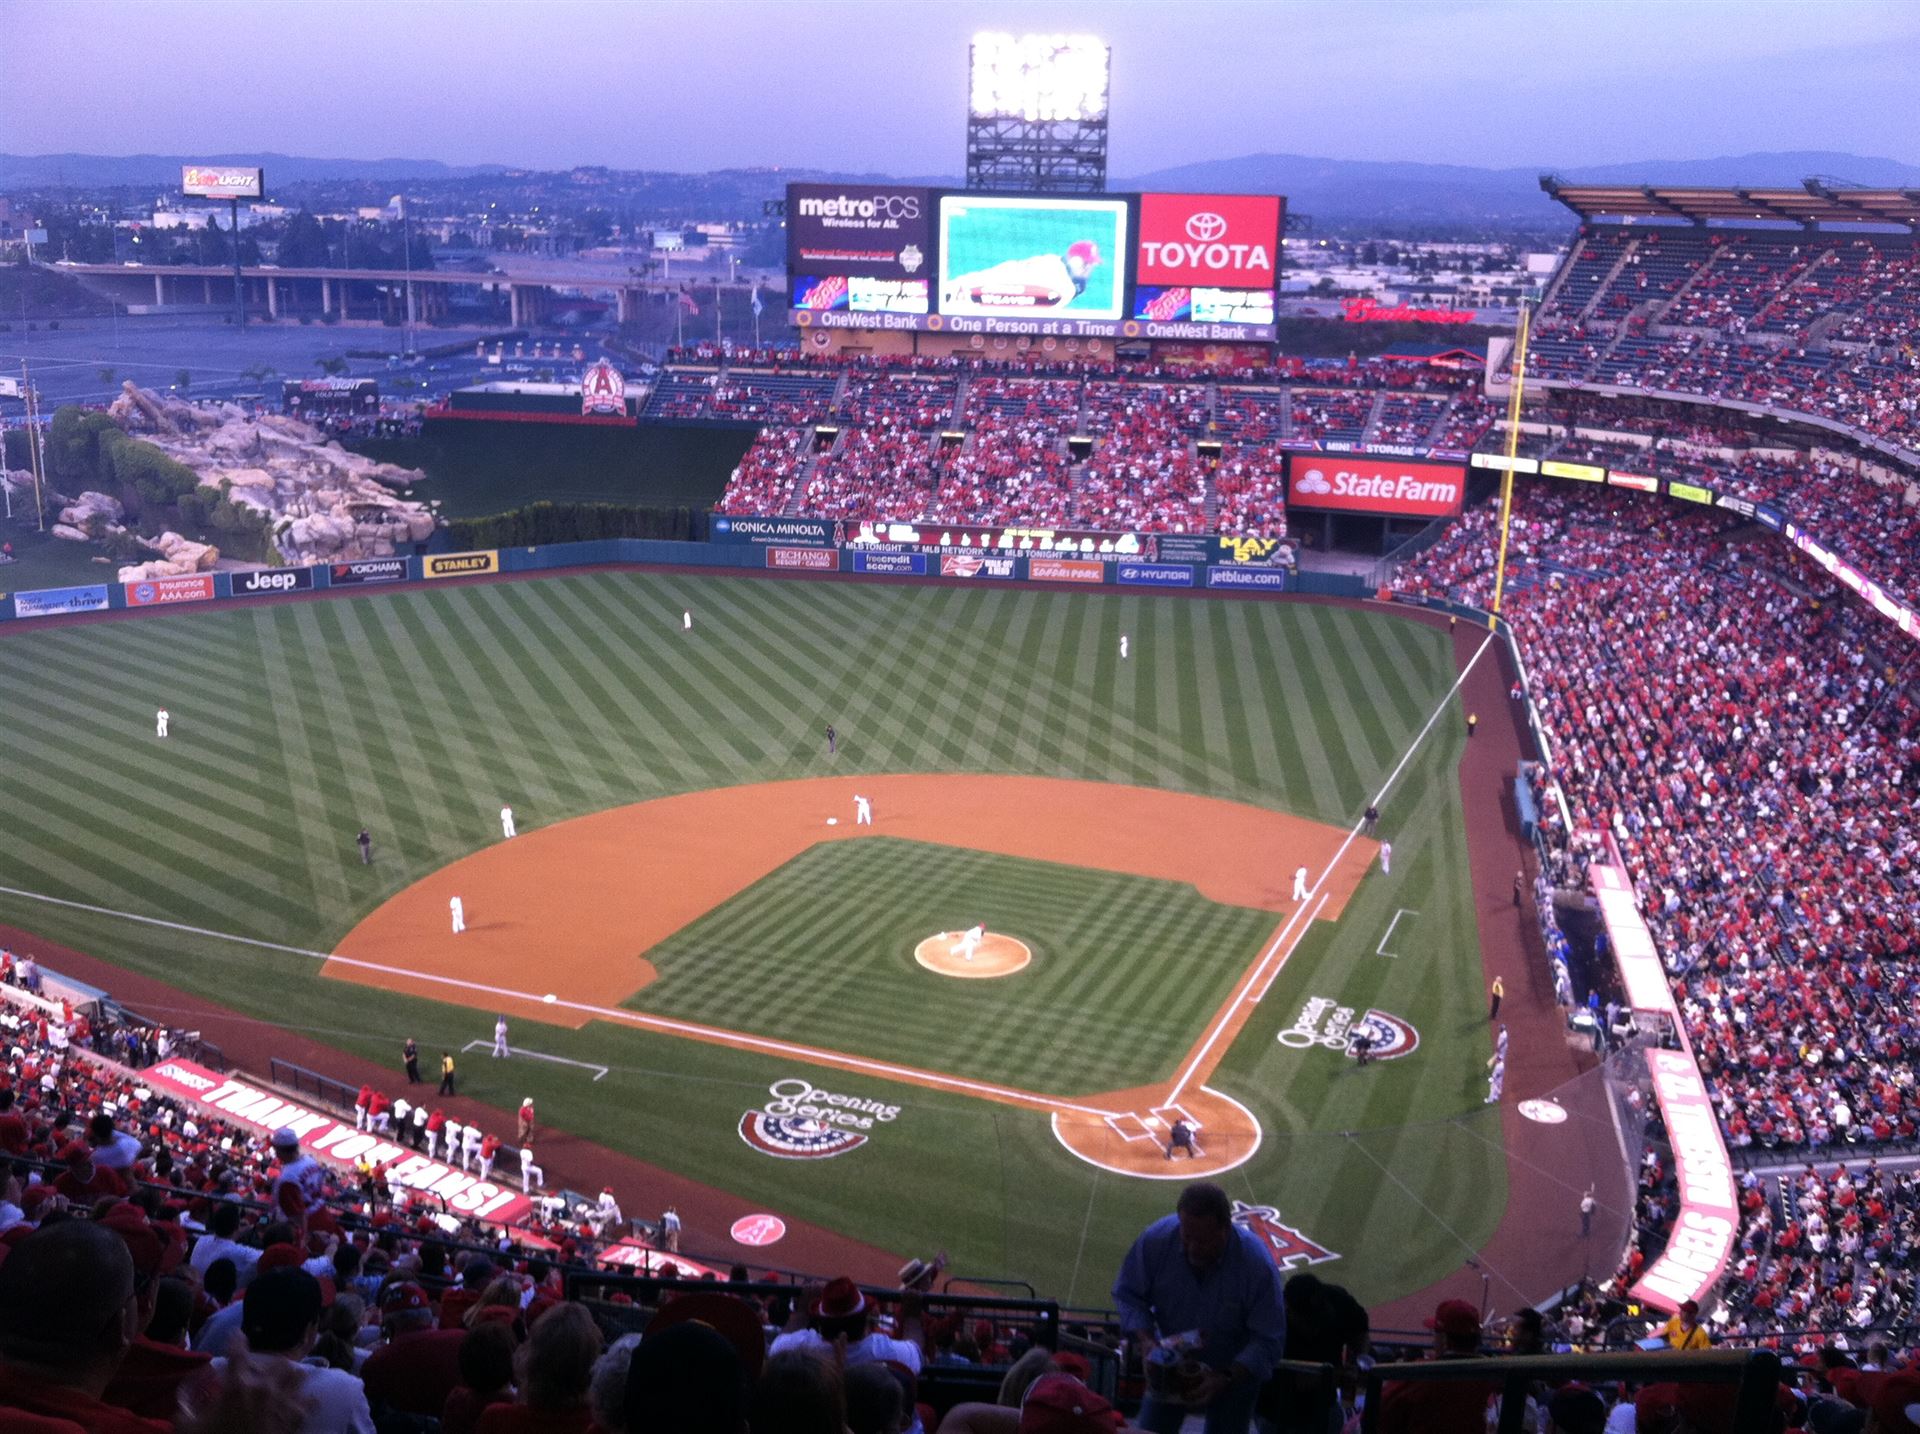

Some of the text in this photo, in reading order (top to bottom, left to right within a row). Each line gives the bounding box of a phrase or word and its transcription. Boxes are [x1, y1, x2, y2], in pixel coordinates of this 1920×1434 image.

[218, 175, 254, 186] LIGHT
[799, 195, 919, 219] metroPCS
[822, 217, 865, 228] Wireless
[867, 218, 881, 229] for
[1142, 242, 1270, 270] TOYOTA
[821, 312, 917, 329] OneWest Bank
[950, 316, 1115, 336] One Person at a Time
[1146, 323, 1209, 338] OneWest
[1211, 325, 1245, 339] Bank
[1326, 441, 1350, 452] MINI
[1366, 444, 1414, 456] STORAGE
[731, 521, 825, 536] KONICA MINOLTA
[1219, 536, 1277, 550] MAY
[775, 550, 831, 561] PECHANGA
[845, 542, 864, 550] MLB
[864, 543, 902, 552] TONIGHT
[941, 547, 985, 556] NETWORK
[1025, 551, 1063, 559] TONIGHT
[1101, 554, 1143, 562] NETWORK
[1233, 548, 1266, 562] 5TH
[350, 562, 402, 574] YOKOHAMA
[434, 558, 487, 571] STANLEY
[1032, 567, 1100, 579] SAFARI PARK
[1140, 569, 1190, 580] HYUNDAI
[1210, 570, 1281, 584] jetblue.com
[159, 579, 205, 590] Insurance
[246, 572, 296, 590] Jeep
[160, 590, 206, 601] AAA.com
[768, 1078, 901, 1122] Opening
[764, 1098, 875, 1130] Series
[201, 1080, 331, 1138] THANK
[311, 1124, 404, 1167] YOU
